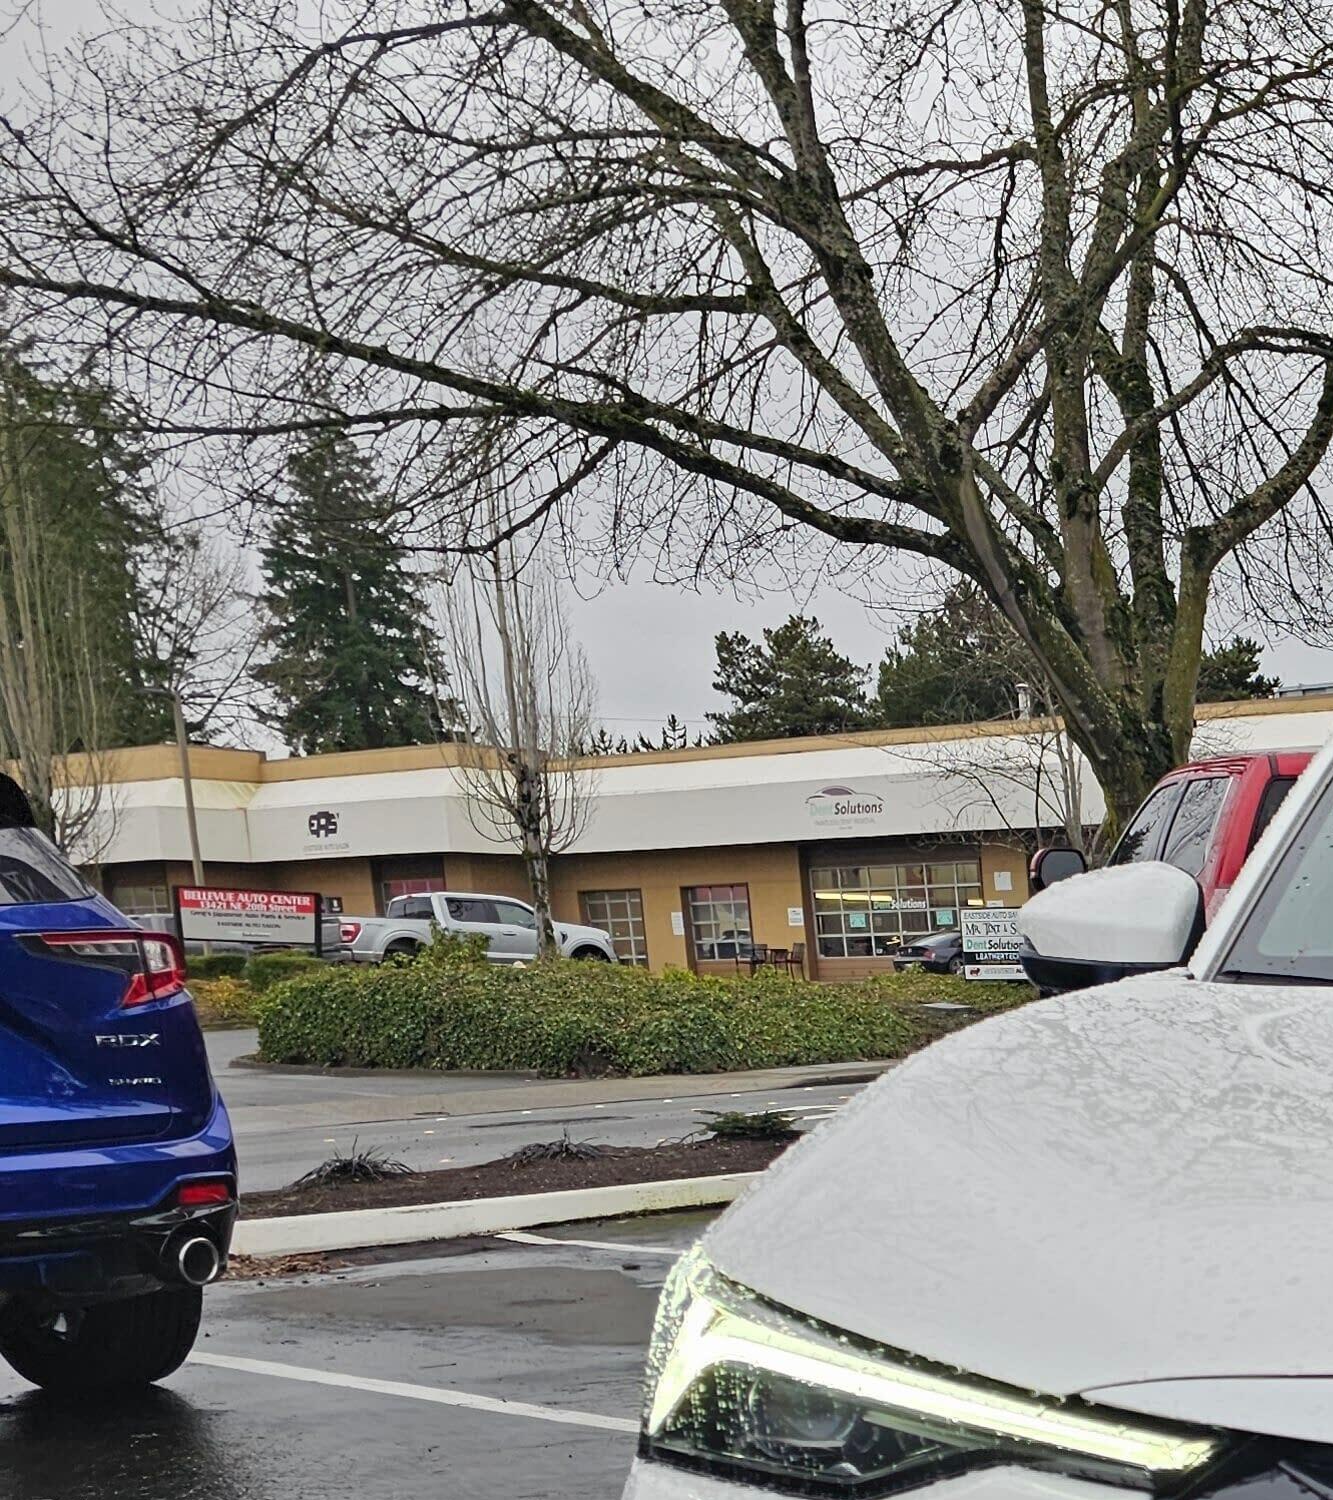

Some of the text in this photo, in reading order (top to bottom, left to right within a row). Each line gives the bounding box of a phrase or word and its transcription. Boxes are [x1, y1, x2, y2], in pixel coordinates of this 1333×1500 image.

[183, 890, 310, 906] BELLEVUE AUTO CENTER
[230, 901, 243, 910] NE
[246, 902, 267, 912] 20th
[269, 903, 297, 913] Street
[95, 1033, 160, 1047] RDX
